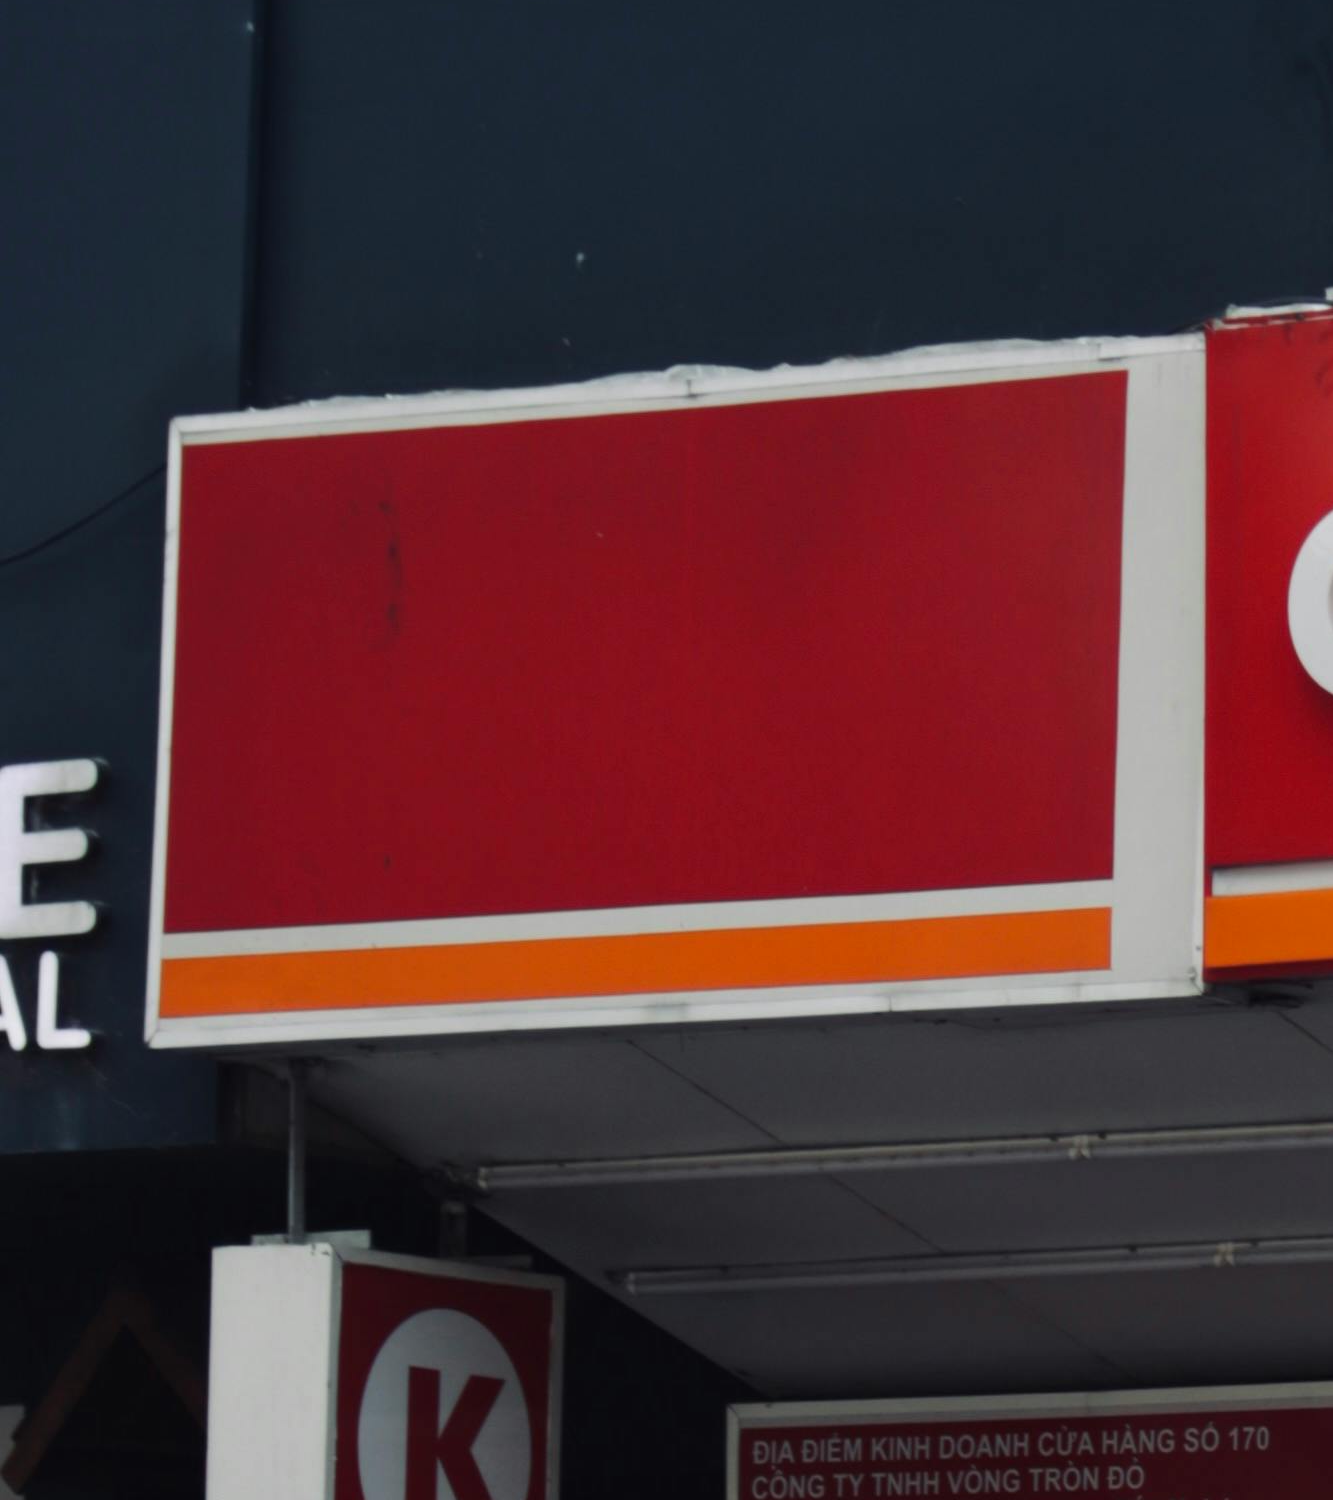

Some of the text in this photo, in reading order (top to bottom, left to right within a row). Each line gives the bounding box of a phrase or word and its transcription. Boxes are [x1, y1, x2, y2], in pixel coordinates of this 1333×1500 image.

[752, 1421, 1271, 1470] ĐỊA ĐIỂM KINH DOANH CỬA HÀNG SỐ 170
[751, 1469, 825, 1500] CÔNG
[833, 1473, 865, 1498] TY
[871, 1471, 940, 1497] TNHH
[946, 1464, 1021, 1495] VÒNG
[1028, 1460, 1100, 1493] TRÒN
